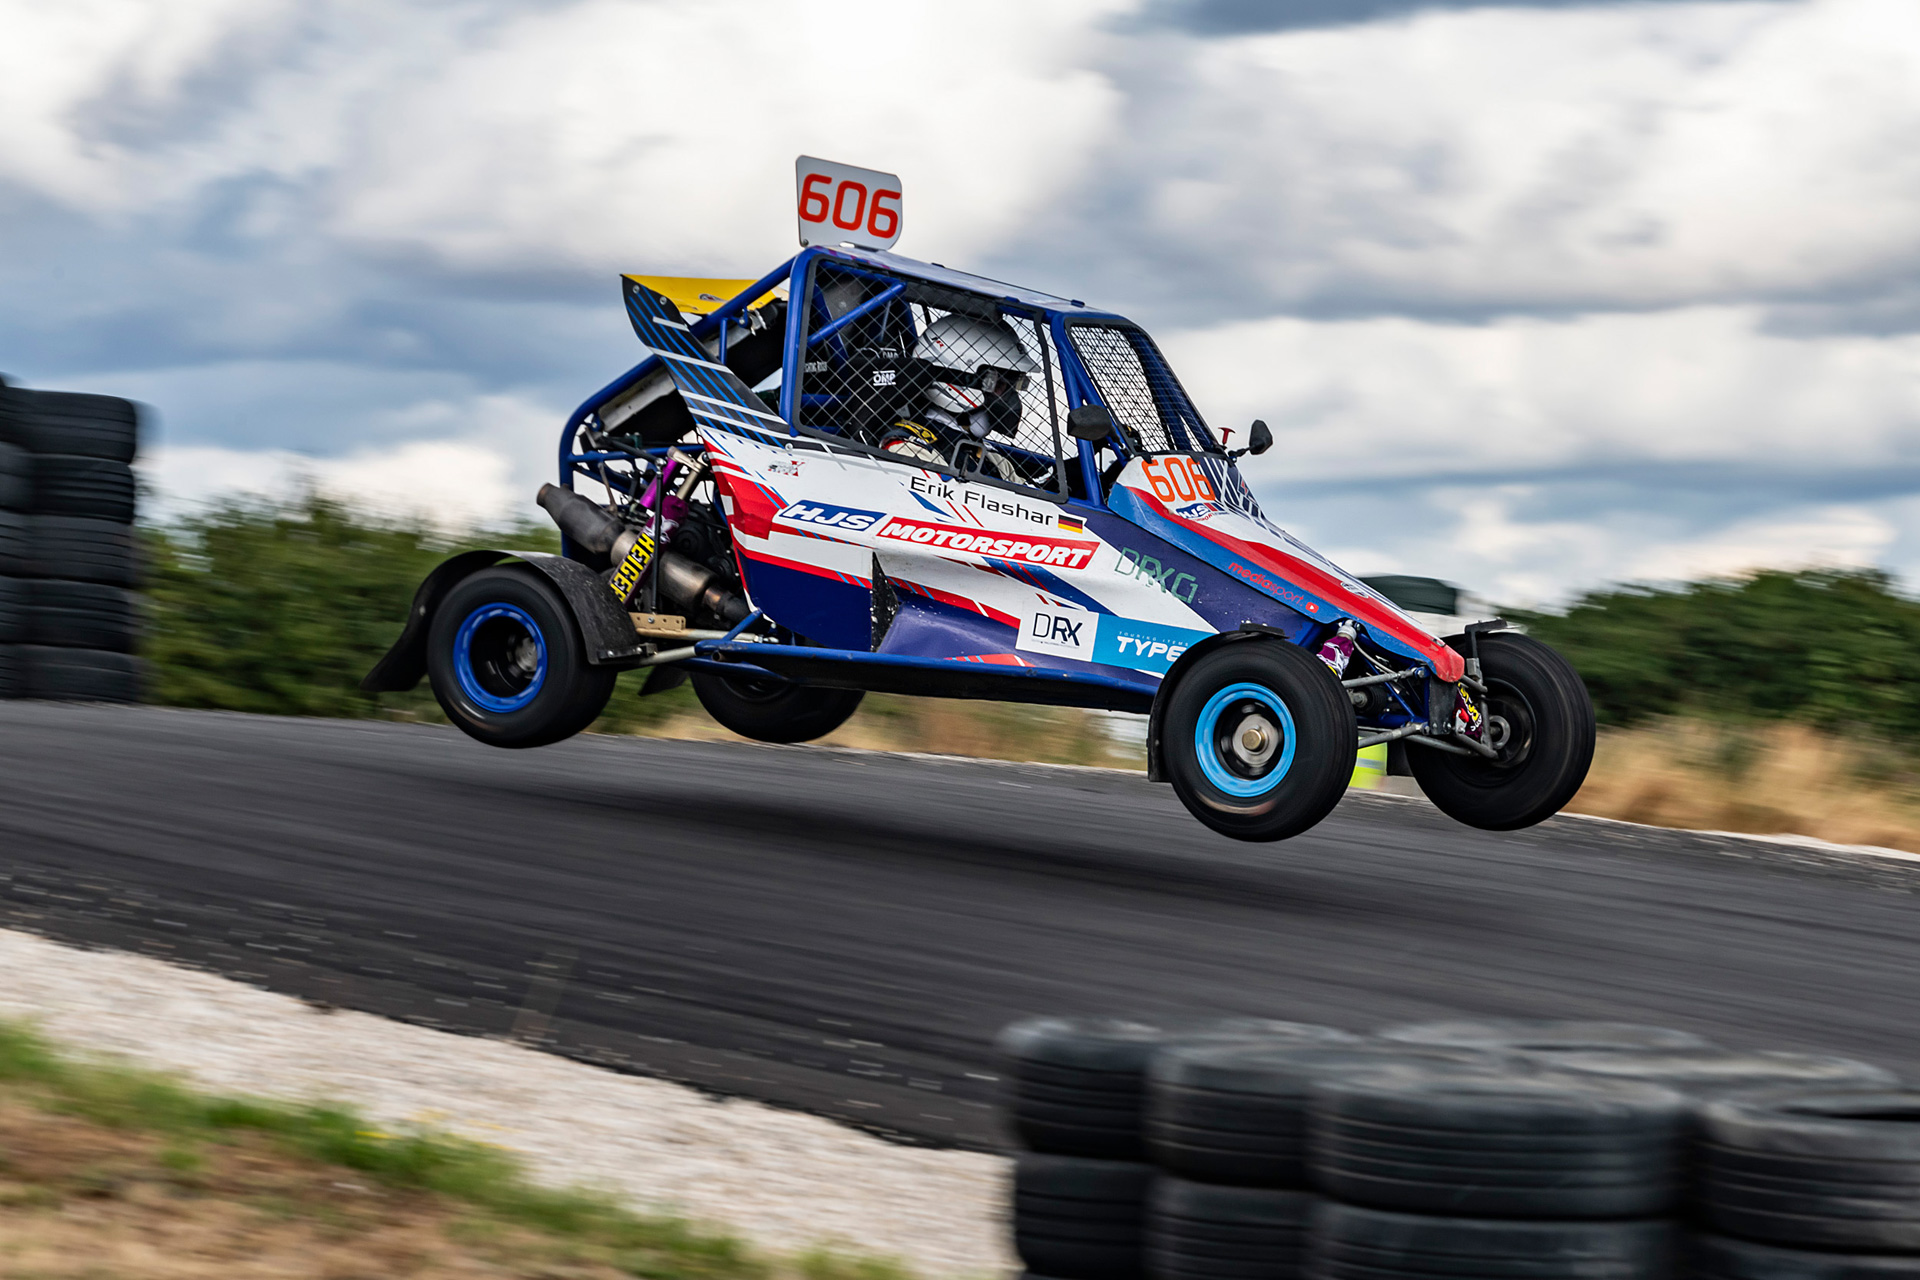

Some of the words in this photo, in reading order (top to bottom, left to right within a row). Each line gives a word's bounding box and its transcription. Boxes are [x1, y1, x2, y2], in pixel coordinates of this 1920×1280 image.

[798, 173, 901, 239] 606
[873, 372, 896, 384] OMP
[1141, 457, 1216, 502] 606
[910, 476, 954, 501] Erik
[964, 490, 1053, 526] Flashar
[783, 504, 876, 529] HJS
[880, 524, 1092, 567] MOTORSPORT
[1032, 613, 1083, 646] DRX
[1117, 635, 1188, 662] TYPE
[1119, 631, 1157, 641] TOURING
